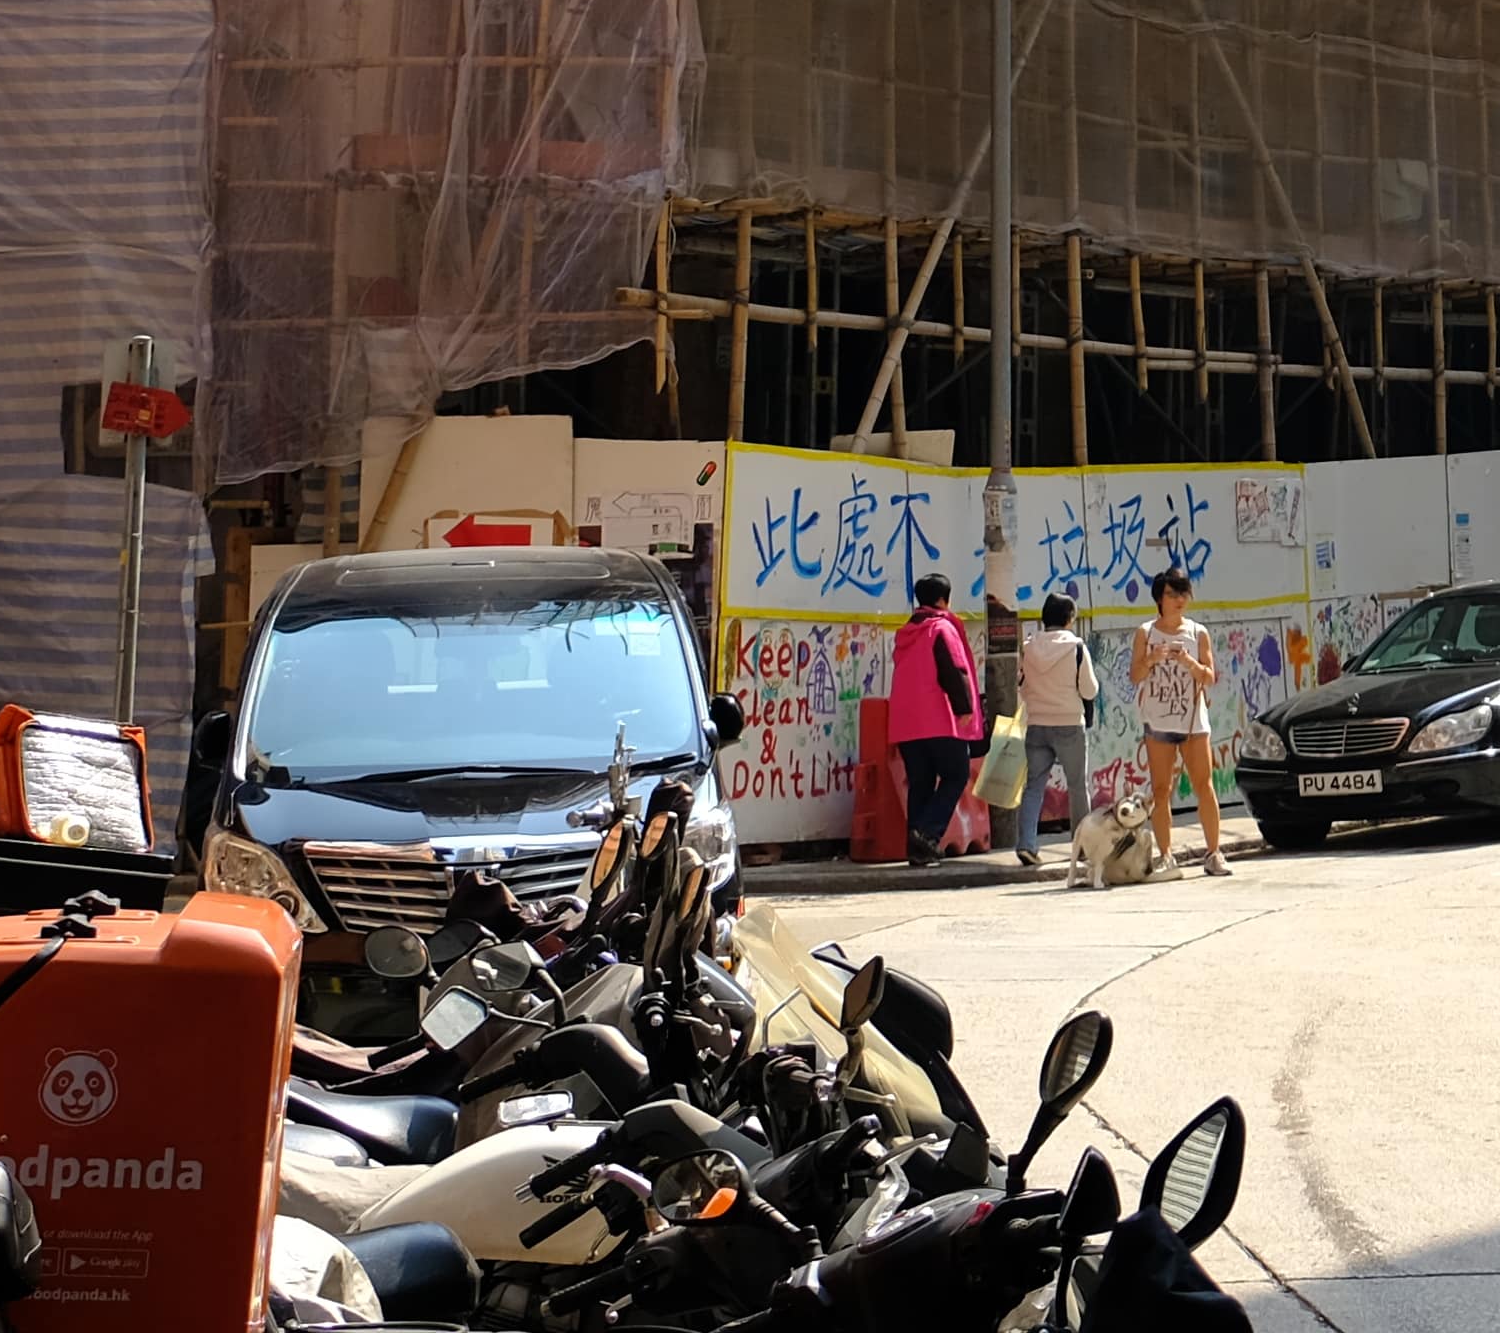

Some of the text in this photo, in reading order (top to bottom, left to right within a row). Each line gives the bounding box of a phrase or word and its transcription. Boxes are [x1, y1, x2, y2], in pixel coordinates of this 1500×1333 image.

[752, 472, 1213, 609] 此處不垃圾站
[736, 621, 811, 686] Keep
[760, 728, 778, 765] &
[731, 749, 805, 800] Don't
[1303, 773, 1377, 792] PU 4484
